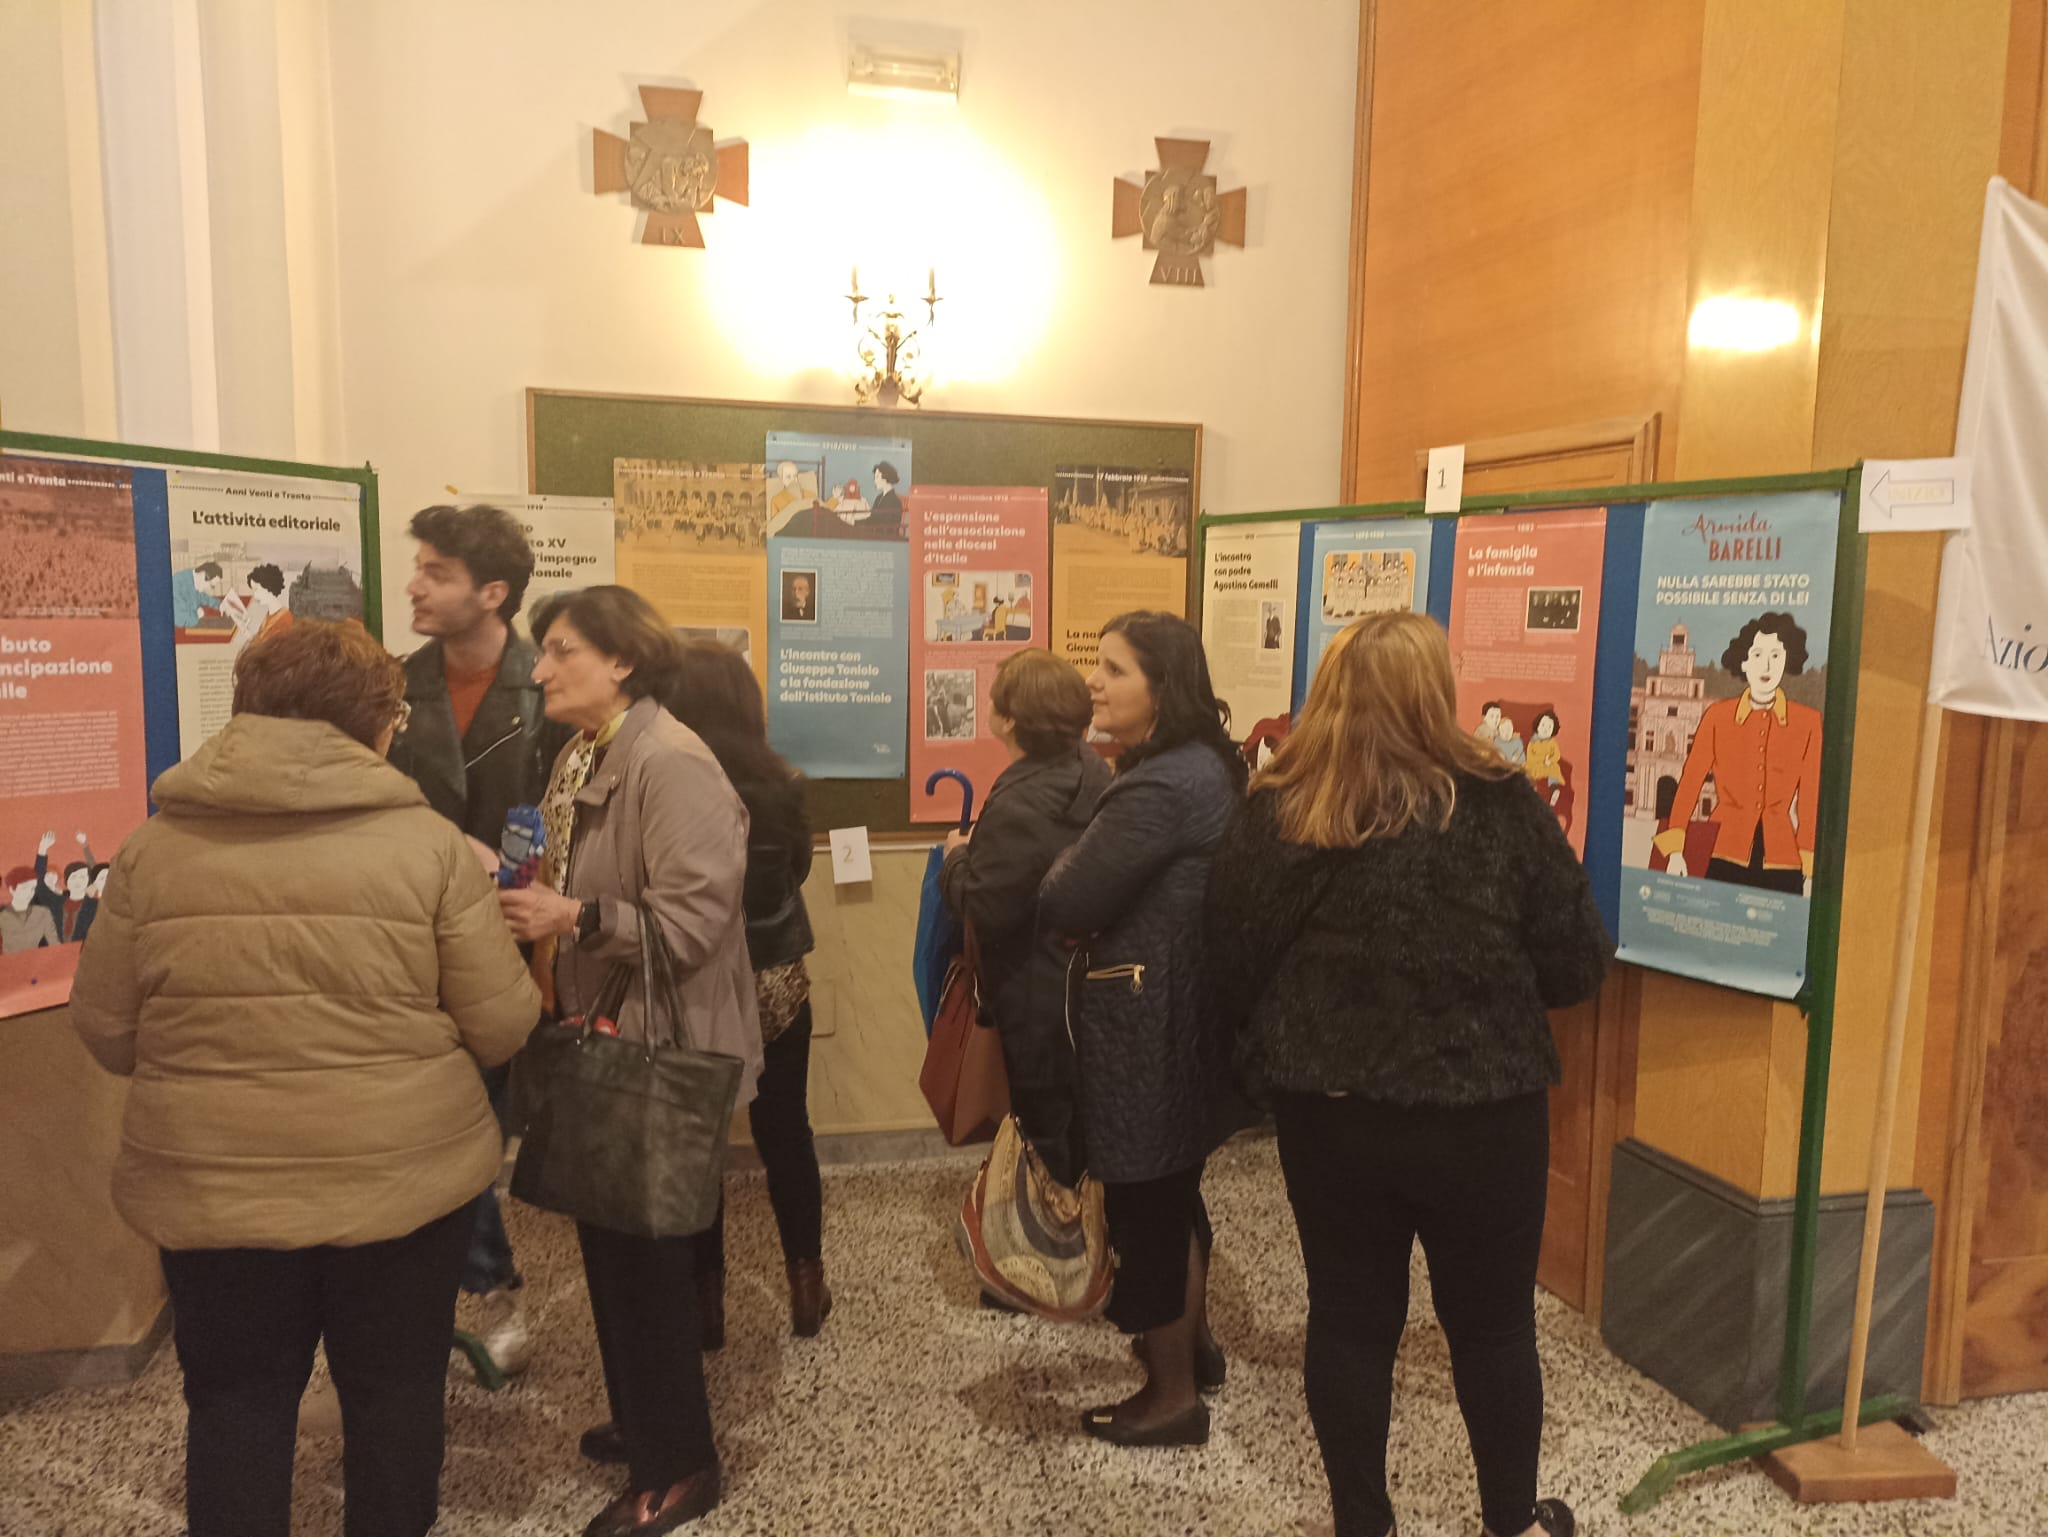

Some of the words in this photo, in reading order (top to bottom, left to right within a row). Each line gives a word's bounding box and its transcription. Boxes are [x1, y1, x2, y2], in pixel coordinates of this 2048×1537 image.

[658, 226, 686, 245] IX
[1160, 265, 1197, 284] VIII
[26, 472, 66, 487] Trenta
[1438, 467, 1447, 490] 1
[225, 487, 247, 497] Anni
[249, 488, 273, 499] Venti
[282, 490, 311, 501] Trenta
[192, 510, 266, 528] L'attività
[268, 515, 341, 532] editoriale
[923, 511, 1000, 523] L'espansione
[923, 525, 1026, 538] dell'associazione
[1681, 509, 1773, 543] Armida
[547, 537, 566, 549] XV
[923, 538, 953, 550] nelle
[955, 538, 997, 550] diocesi
[1708, 536, 1782, 561] BARELLI
[923, 552, 968, 564] d'Italia
[1214, 552, 1252, 563] L'incontro
[1468, 547, 1483, 561] La
[1485, 544, 1538, 562] famiglia
[1214, 567, 1228, 576] con
[1228, 566, 1252, 578] padre
[1467, 567, 1475, 577] e
[1476, 562, 1535, 577] l'infanzia
[1213, 580, 1248, 593] Agostino
[1248, 579, 1279, 590] Gemelli
[1657, 575, 1700, 590] NULLA
[1701, 574, 1760, 590] SAREBBE
[1764, 573, 1810, 589] STATO
[1656, 591, 1720, 606] POSSIBILE
[1722, 591, 1767, 606] SENZA
[1769, 591, 1785, 606] DI
[1787, 591, 1810, 606] LEI
[1066, 629, 1080, 639] La
[780, 648, 838, 661] L'incontro
[839, 650, 861, 662] con
[780, 662, 835, 677] Giuseppe
[836, 663, 880, 677] Toniolo
[789, 676, 801, 688] la
[803, 676, 870, 690] fondazione
[780, 690, 848, 703] dell'Istituto
[849, 691, 892, 704] Toniolo
[842, 845, 855, 863] 2
